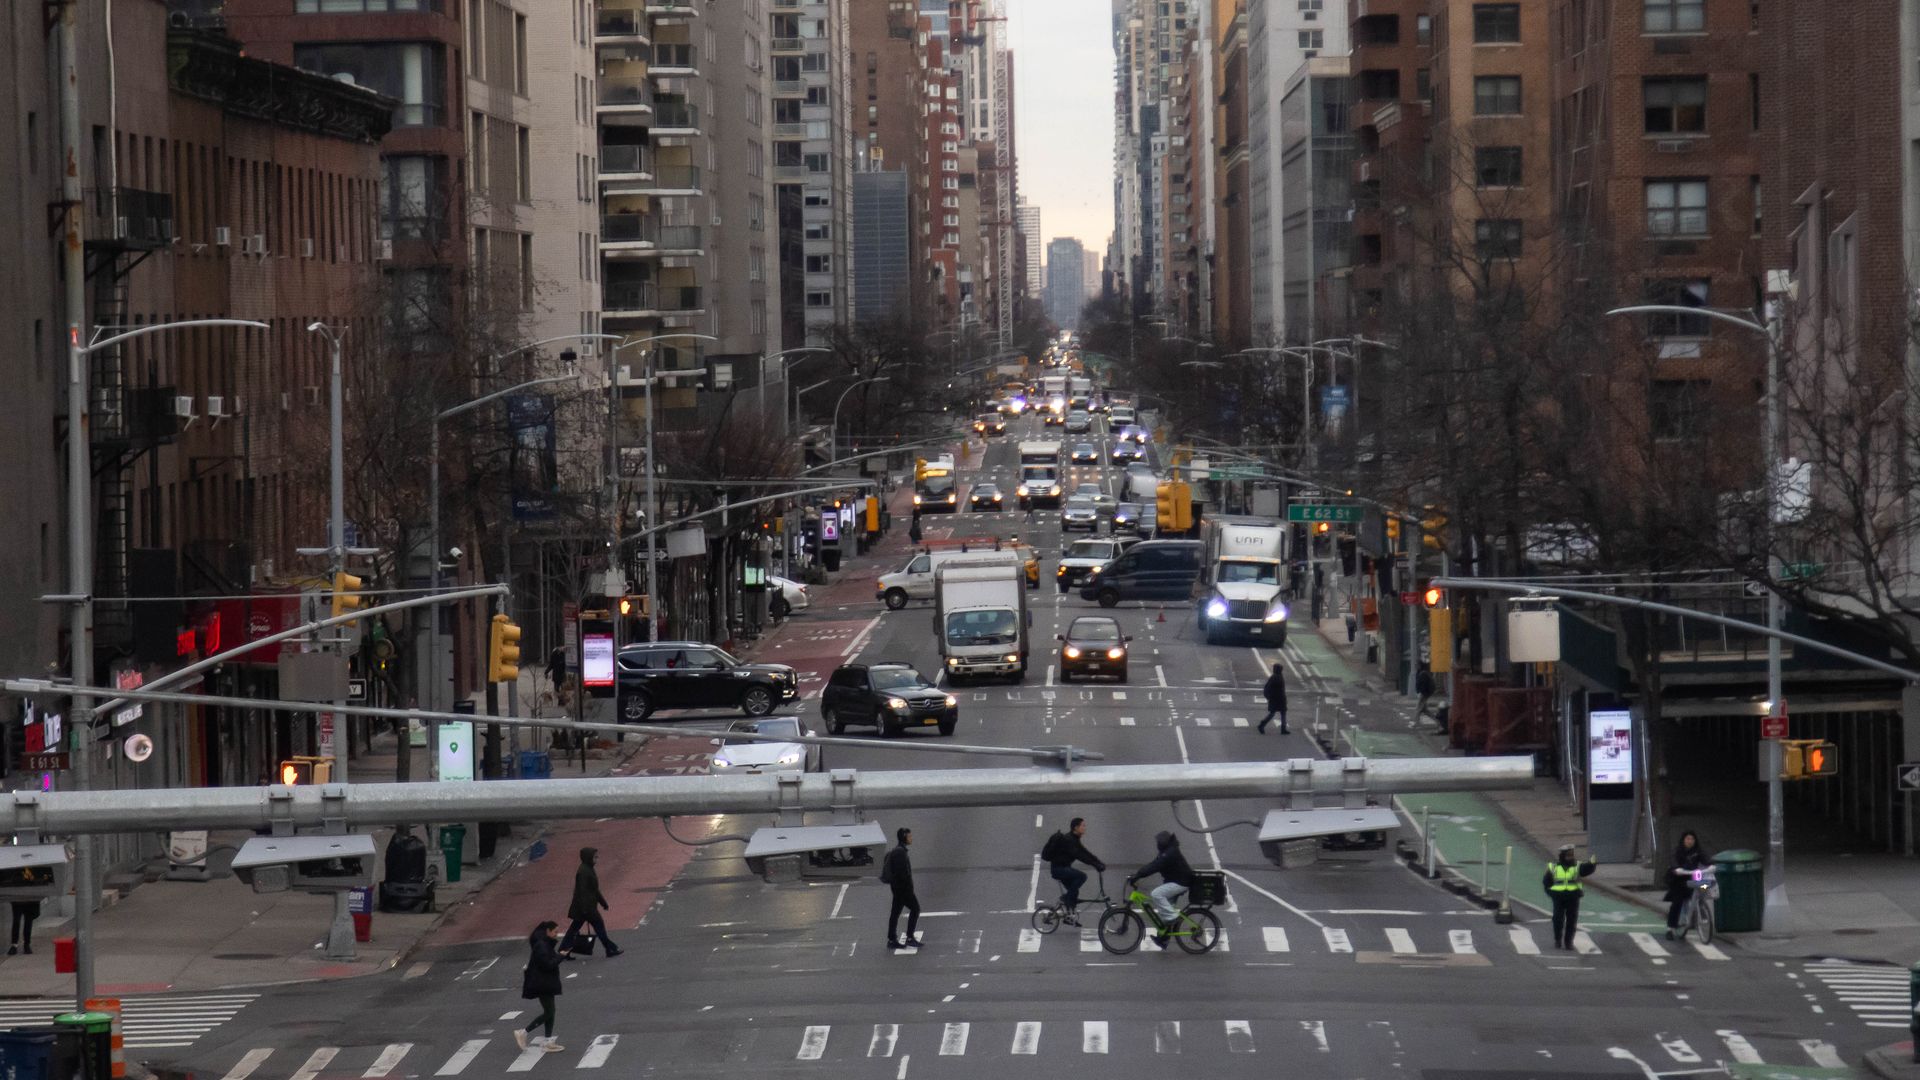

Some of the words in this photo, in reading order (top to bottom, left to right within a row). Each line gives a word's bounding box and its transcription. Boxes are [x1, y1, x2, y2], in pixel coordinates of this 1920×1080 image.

[1303, 508, 1311, 519] E
[1314, 508, 1331, 519] 62
[1336, 508, 1350, 519] St
[30, 756, 35, 769] E
[38, 756, 48, 769] 61
[50, 756, 60, 769] St
